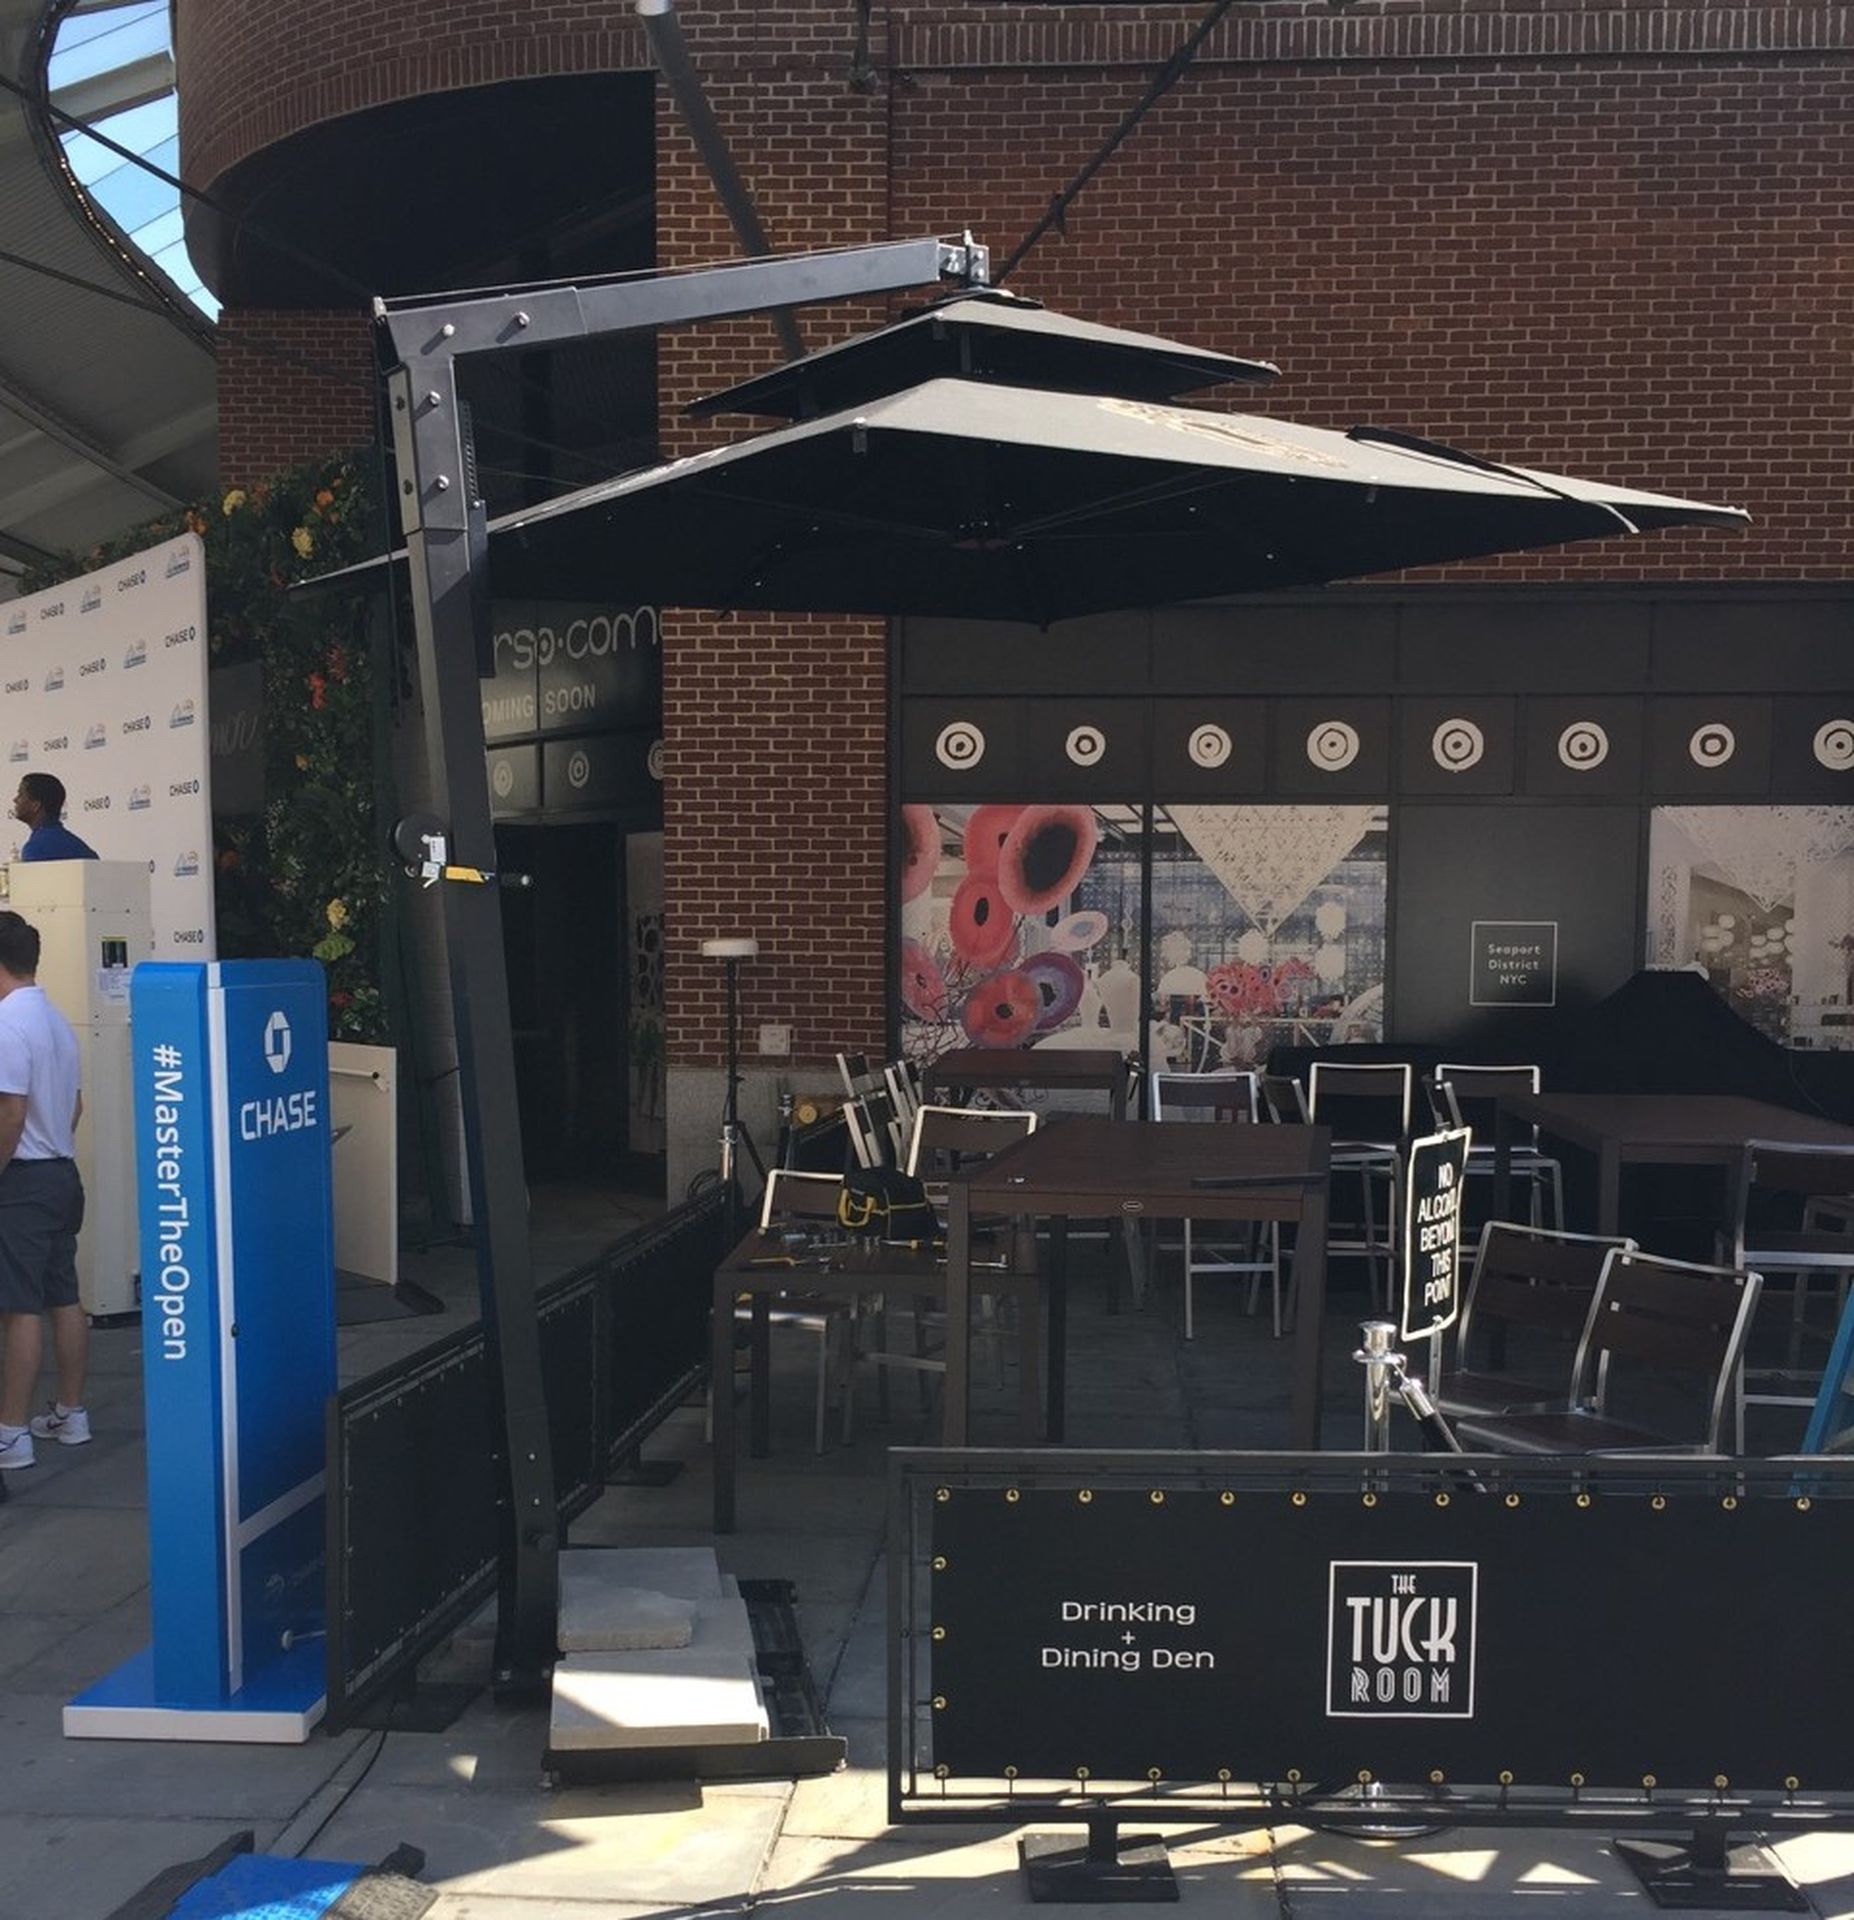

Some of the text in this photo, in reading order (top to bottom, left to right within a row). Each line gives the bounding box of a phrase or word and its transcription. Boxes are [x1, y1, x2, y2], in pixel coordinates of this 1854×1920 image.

[117, 572, 139, 592] CHASE
[165, 629, 188, 648] CHASE
[545, 684, 596, 715] SOON
[122, 718, 145, 735] CHASE
[169, 781, 192, 797] CHASE
[173, 930, 198, 943] CHASE
[1487, 943, 1541, 957] Seaport
[1487, 959, 1539, 970] District
[1499, 974, 1528, 985] NYC
[240, 1090, 317, 1141] CHASE
[1438, 1162, 1454, 1189] NO
[152, 1043, 190, 1361] #MasterTheOpen
[1431, 1248, 1452, 1278] THIS
[1391, 1574, 1417, 1594] THE
[1061, 1601, 1197, 1626] Drinking
[1121, 1631, 1136, 1645] +
[1346, 1597, 1458, 1663] TUCK
[1041, 1647, 1215, 1671] Dining Den
[1351, 1666, 1450, 1703] ROOM
